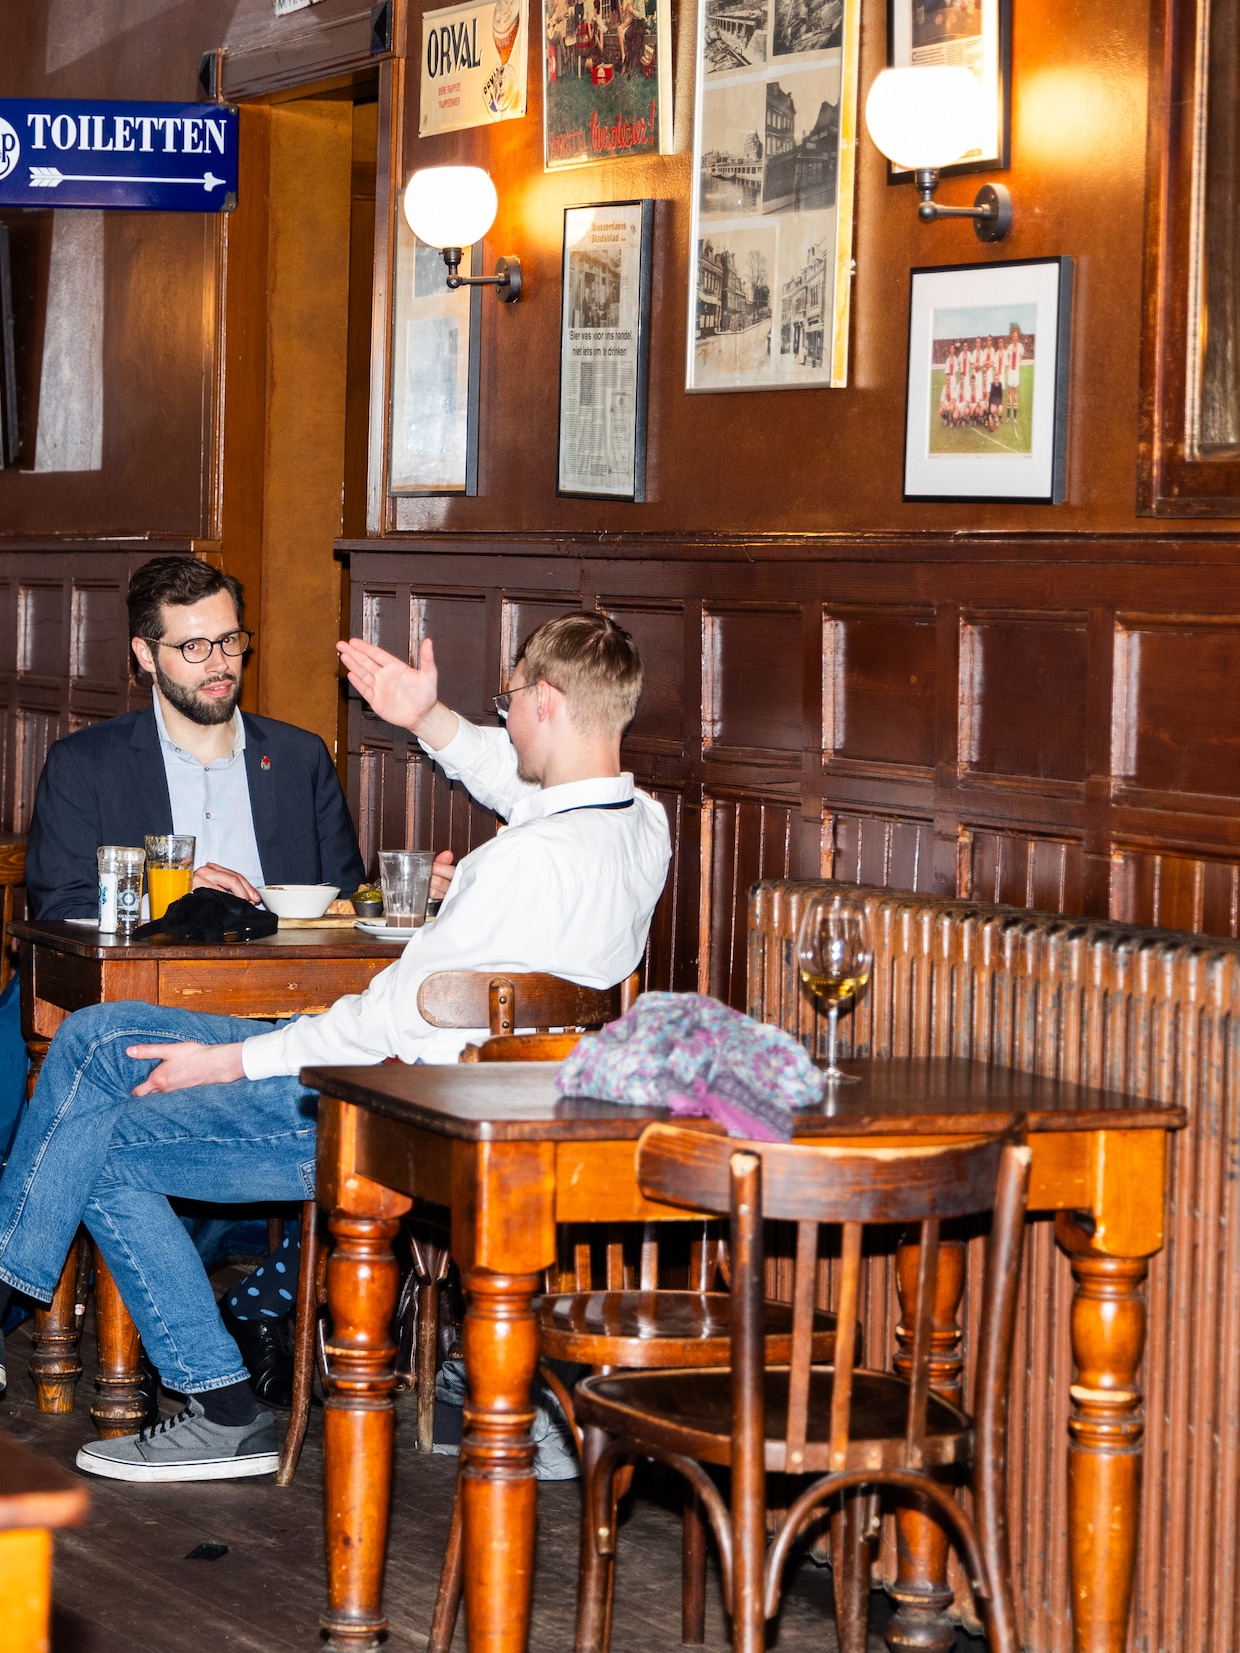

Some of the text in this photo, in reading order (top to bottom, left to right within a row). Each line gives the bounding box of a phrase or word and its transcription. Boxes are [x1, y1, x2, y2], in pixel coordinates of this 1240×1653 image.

[427, 17, 481, 78] ORVAL
[27, 113, 227, 154] TOILETTEN
[550, 130, 588, 159] AMSTEL
